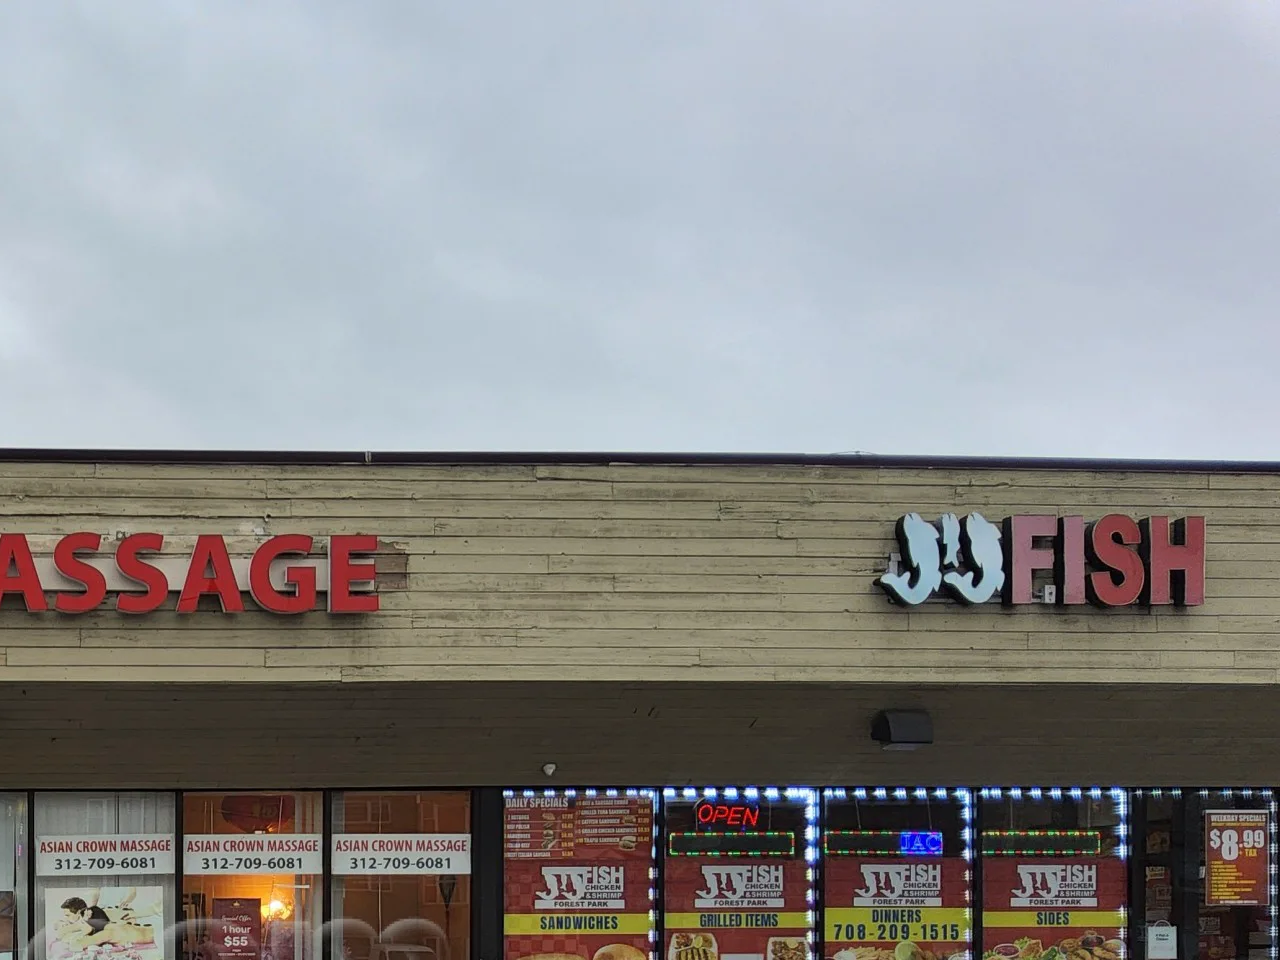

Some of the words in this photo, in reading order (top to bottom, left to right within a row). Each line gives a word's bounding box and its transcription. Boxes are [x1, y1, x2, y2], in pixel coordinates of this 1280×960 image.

[1010, 513, 1206, 606] FISH
[505, 797, 528, 808] DAILY
[530, 797, 568, 808] SPECIALS
[697, 804, 759, 826] OPEN
[40, 840, 74, 853] ASIAN
[76, 840, 117, 852] CROWN
[120, 839, 171, 852] MASSAGE
[187, 840, 220, 853] ASIAN
[223, 840, 264, 852] CROWN
[267, 839, 319, 852] MASSAGE
[335, 840, 369, 853] ASIAN
[371, 840, 414, 852] CROWN
[416, 839, 467, 852] MASSAGE
[1209, 829, 1265, 860] $8.99
[1245, 849, 1257, 857] TAX
[54, 857, 156, 870] 312-709-6081
[201, 857, 303, 870] 312-709-6081
[350, 857, 452, 870] 312-709-6081
[586, 866, 624, 884] FISH
[744, 865, 783, 883] FISH
[901, 864, 941, 882] FISH
[1060, 865, 1097, 882] FISH
[540, 916, 618, 930] SANDWICHES
[700, 914, 742, 927] GRILLED
[745, 914, 779, 927] ITEMS
[872, 909, 922, 923] DINNERS
[1037, 912, 1070, 925] SIDES
[229, 925, 251, 933] hour
[833, 924, 959, 940] 708-209-1515
[224, 936, 248, 947] $55
